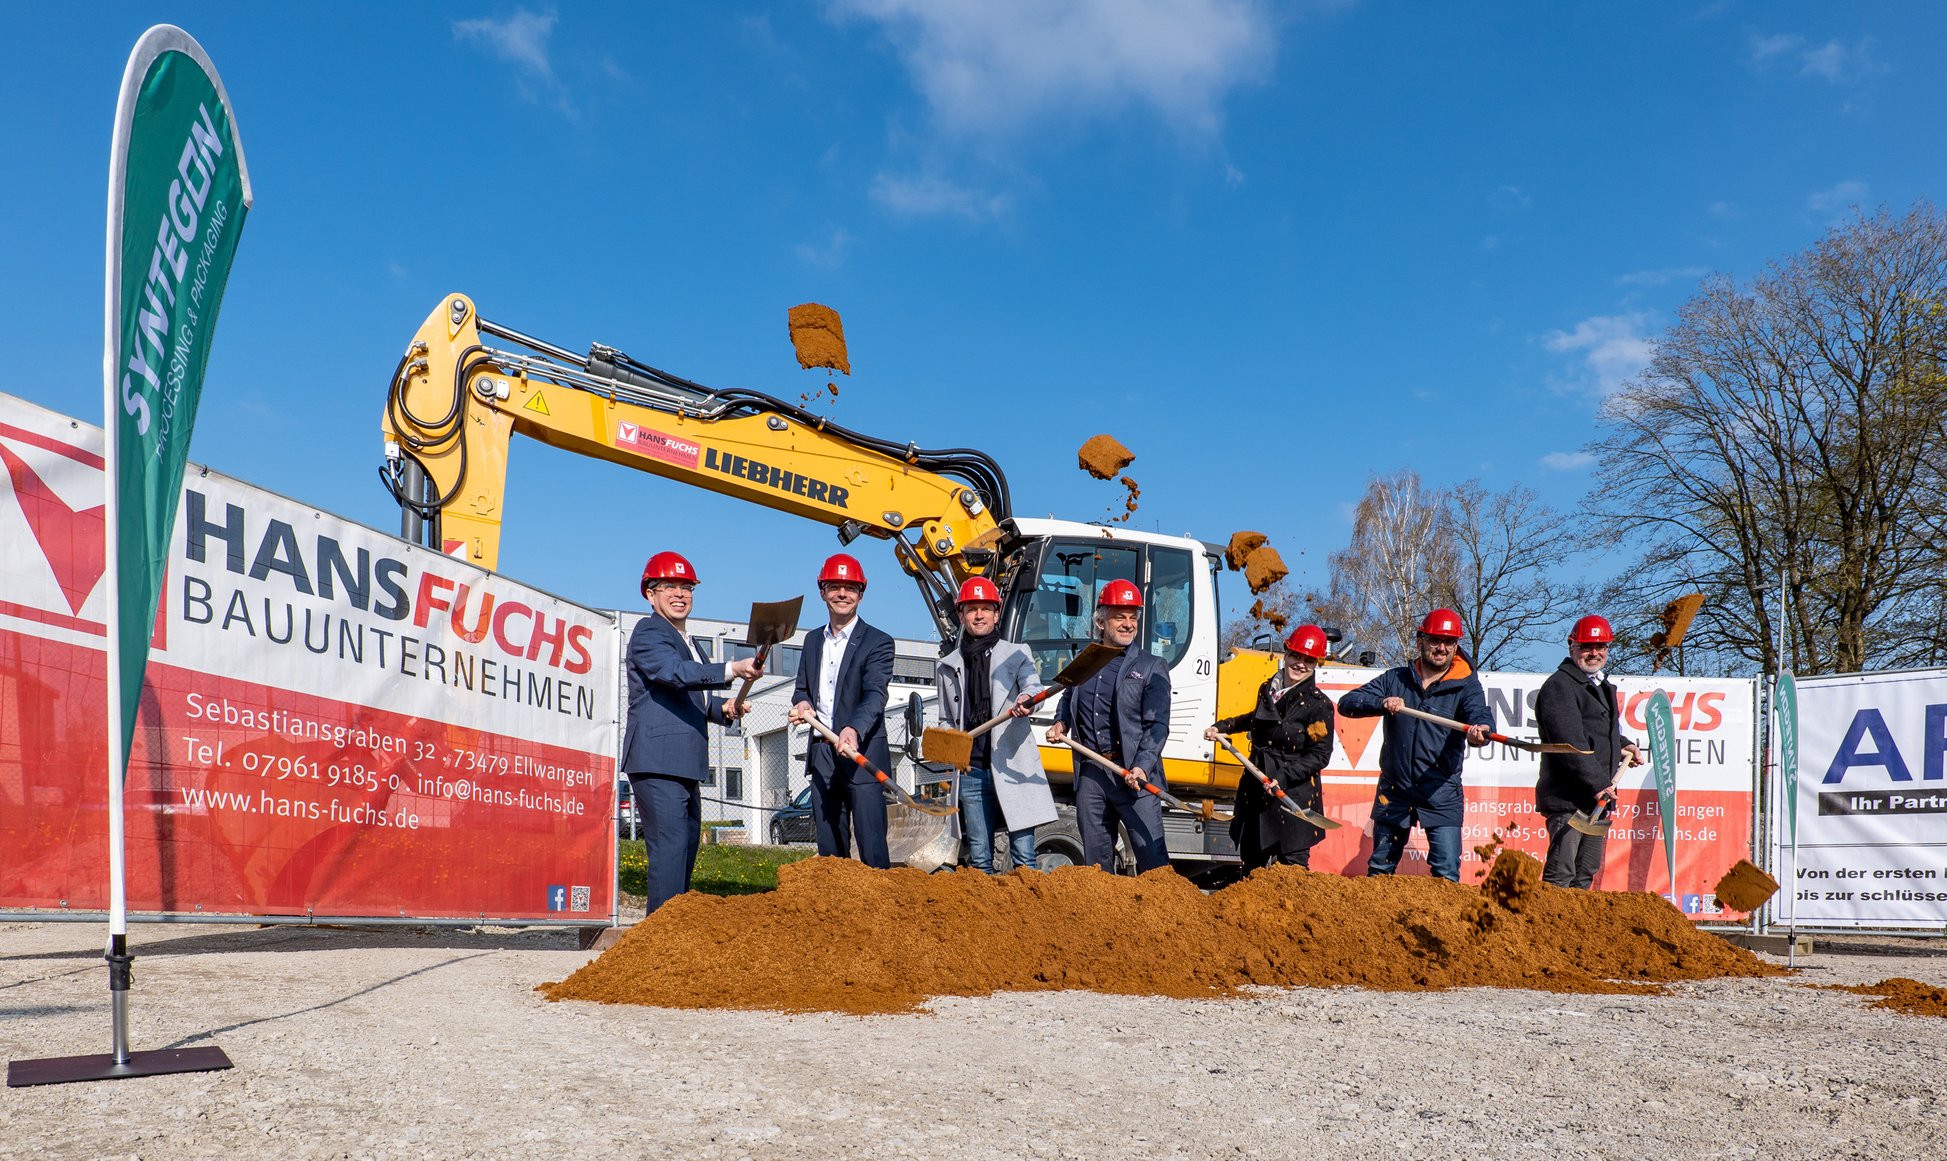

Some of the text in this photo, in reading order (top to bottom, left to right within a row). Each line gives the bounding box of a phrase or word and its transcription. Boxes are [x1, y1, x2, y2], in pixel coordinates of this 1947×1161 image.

[123, 102, 223, 436] SYNTEGON
[156, 200, 228, 465] PROCESSING & PACKAGING
[639, 431, 698, 455] HANSFUCHS
[705, 447, 849, 509] LIEBHERR
[185, 489, 593, 674] HANSFUCHS
[184, 576, 595, 721] BAUUNTERNEHMEN
[1196, 658, 1210, 676] 20
[186, 692, 593, 787] Sebastiansgraben 32 73479 Ellwangen
[182, 736, 584, 815] Tel. 07961 9185-0 info@hans-fuchs.de
[181, 787, 419, 830] www.hans-fuchs.de
[1646, 802, 1724, 819] Elangen
[1851, 796, 1882, 810] Ihr
[1608, 826, 1717, 841] hans-fuhs.de
[1835, 867, 1867, 879] der
[1872, 867, 1937, 879] ersten
[1825, 891, 1854, 901] zur
